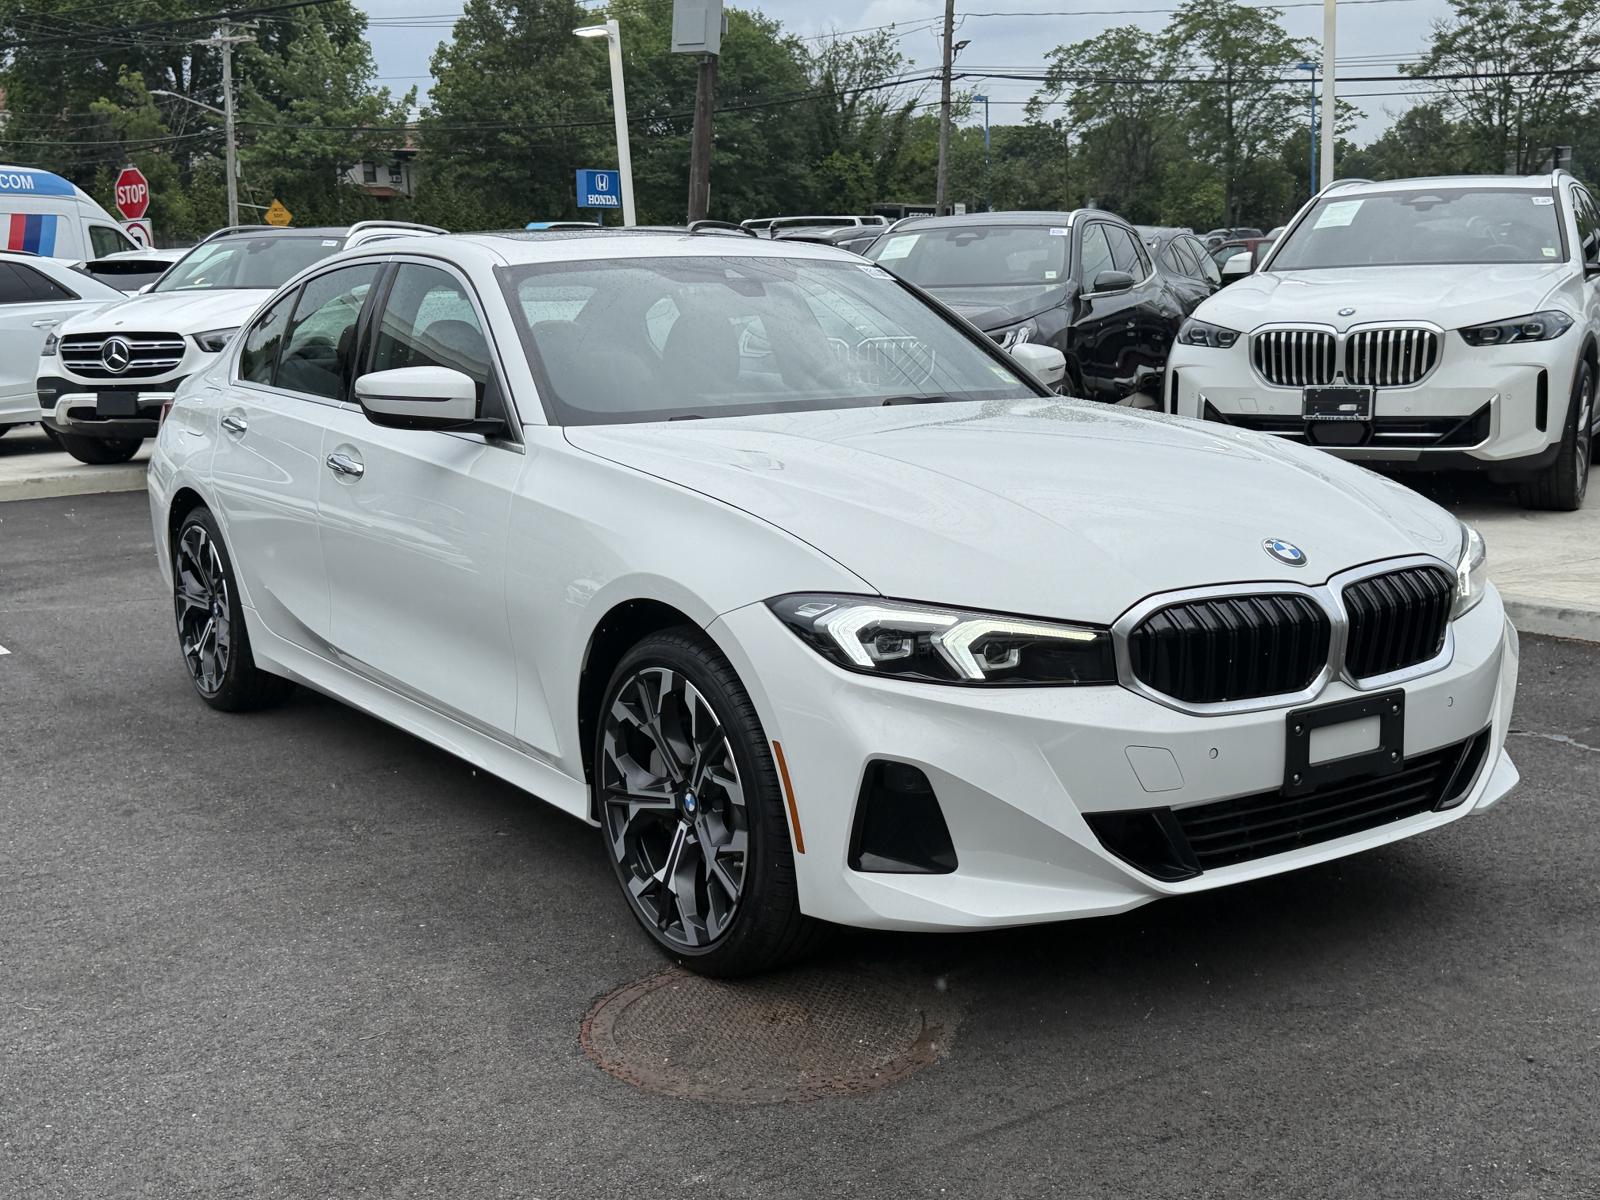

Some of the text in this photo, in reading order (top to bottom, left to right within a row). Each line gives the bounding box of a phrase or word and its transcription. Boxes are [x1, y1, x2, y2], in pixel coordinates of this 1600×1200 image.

[0, 173, 35, 190] COM
[118, 183, 146, 205] STOP
[588, 194, 618, 205] HONDA
